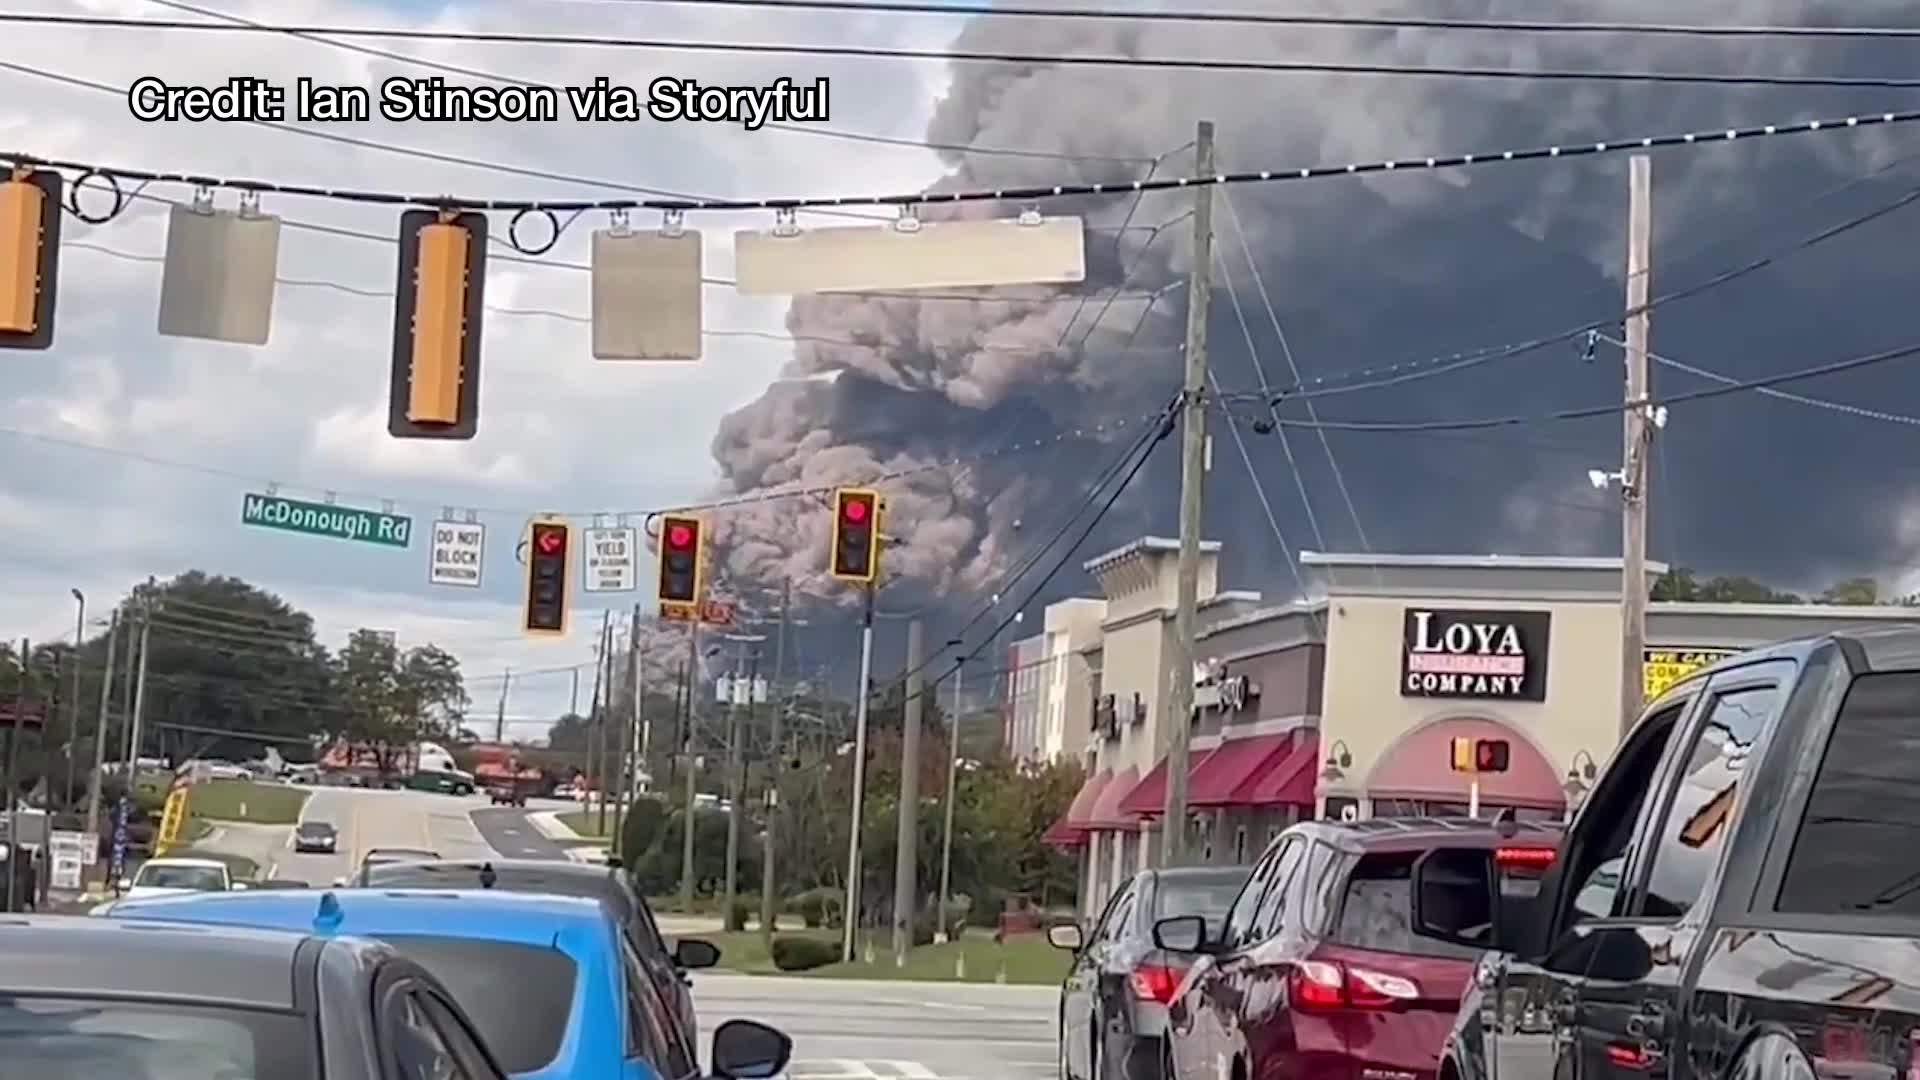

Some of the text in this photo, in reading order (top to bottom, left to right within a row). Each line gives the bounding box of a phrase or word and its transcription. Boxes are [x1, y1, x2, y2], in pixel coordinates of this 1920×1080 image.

[246, 497, 407, 541] McDonough Rd
[437, 529, 479, 546] DO NOT
[436, 549, 477, 564] BLOCK
[1412, 612, 1524, 654] LOYA
[1408, 673, 1524, 693] COMPANY
